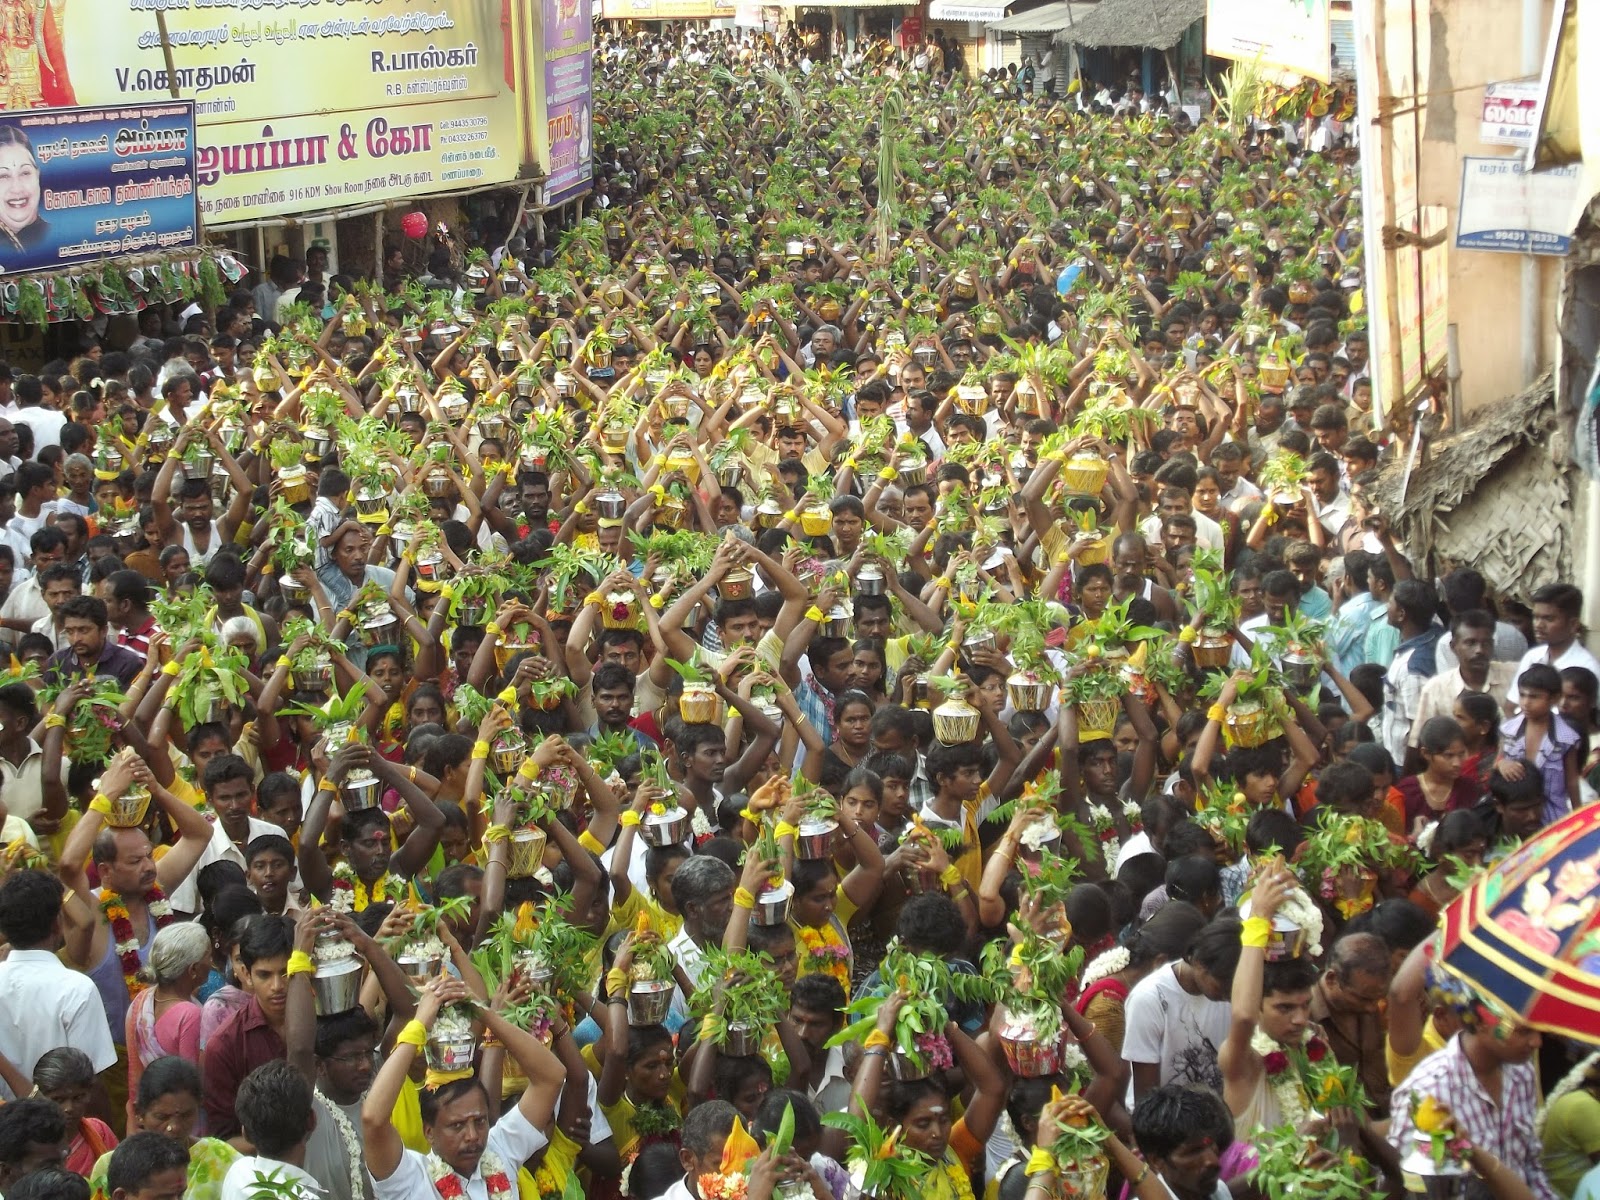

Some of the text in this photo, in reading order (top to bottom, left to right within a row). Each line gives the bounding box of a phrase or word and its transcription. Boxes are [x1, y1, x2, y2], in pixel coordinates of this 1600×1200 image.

[298, 22, 319, 40] என
[320, 17, 370, 40] அன்புடன்
[371, 42, 478, 73] R.பாஸ்கர்
[115, 58, 257, 93] V.கௌதமன்
[386, 83, 405, 96] R.B.
[114, 119, 188, 157] அம்மா
[196, 117, 433, 187] ஐயப்பா & கோ
[44, 187, 111, 211] கோடைகால
[215, 196, 241, 216] நகை
[243, 187, 286, 207] மாளிகை
[289, 187, 304, 200] 916
[305, 186, 321, 199] KDM
[324, 184, 342, 196] Show
[344, 181, 364, 193] Room
[364, 178, 387, 195] நகை
[59, 239, 122, 258] மணப்பாறை
[157, 225, 194, 246] புறநகர்
